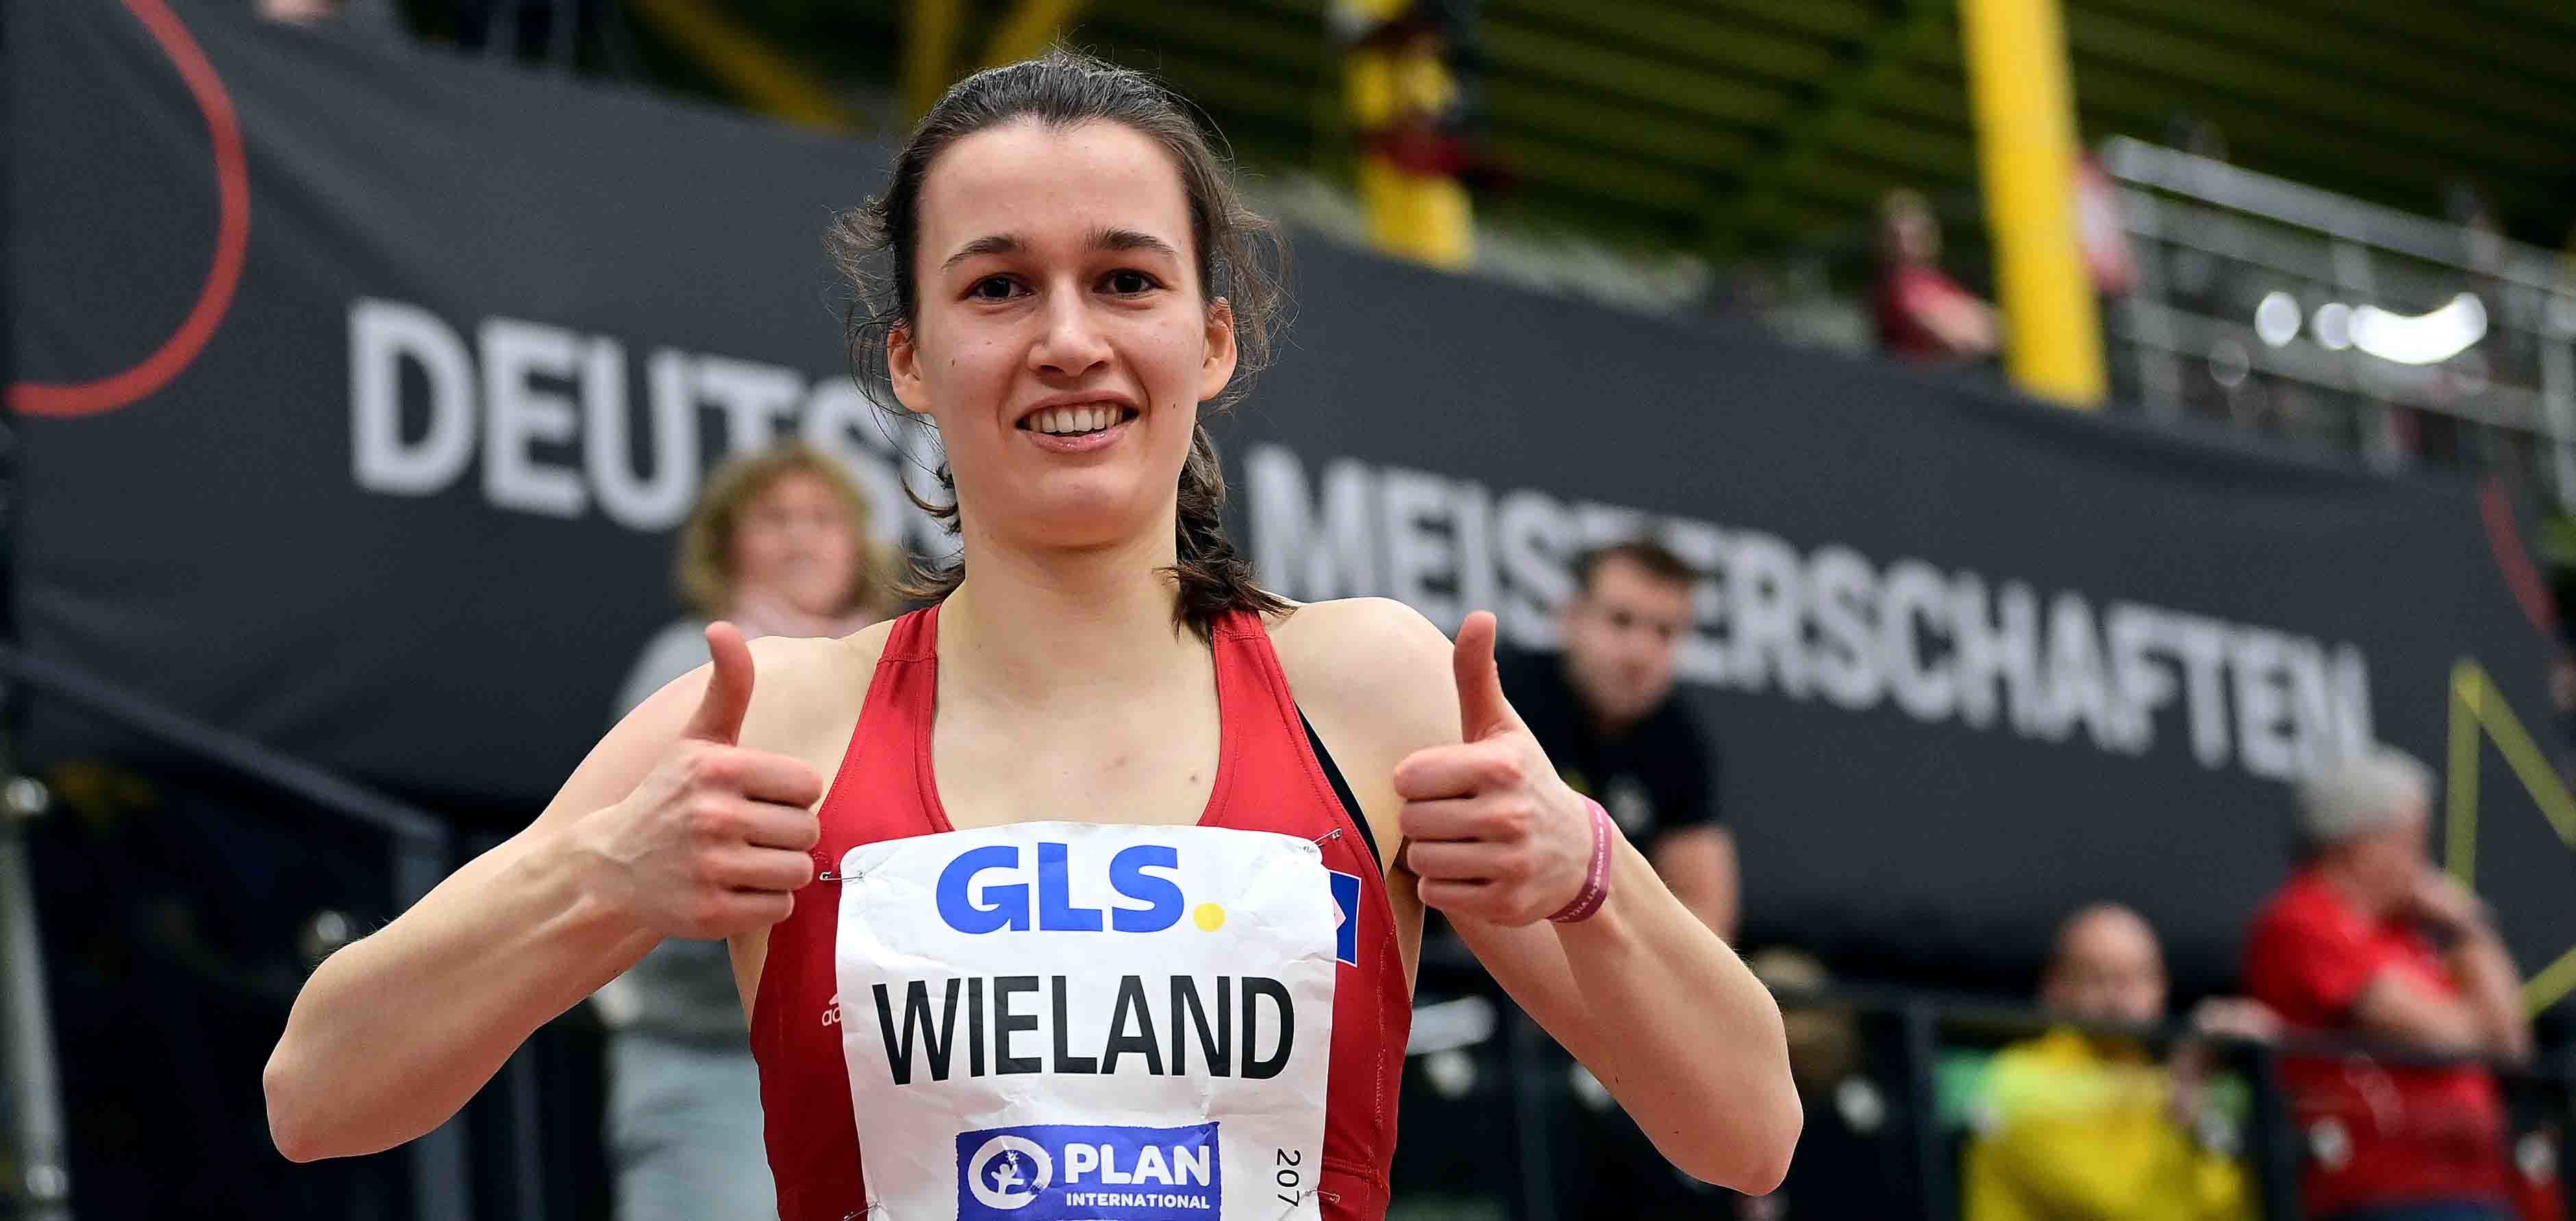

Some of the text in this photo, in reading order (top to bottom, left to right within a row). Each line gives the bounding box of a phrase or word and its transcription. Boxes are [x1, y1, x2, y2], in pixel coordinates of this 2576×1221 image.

[872, 975, 1295, 1086] WIELAND
[1064, 1143, 1210, 1187] PLAN
[1277, 1148, 1301, 1207] 207
[1066, 1193, 1210, 1210] INTERNATIONAL
